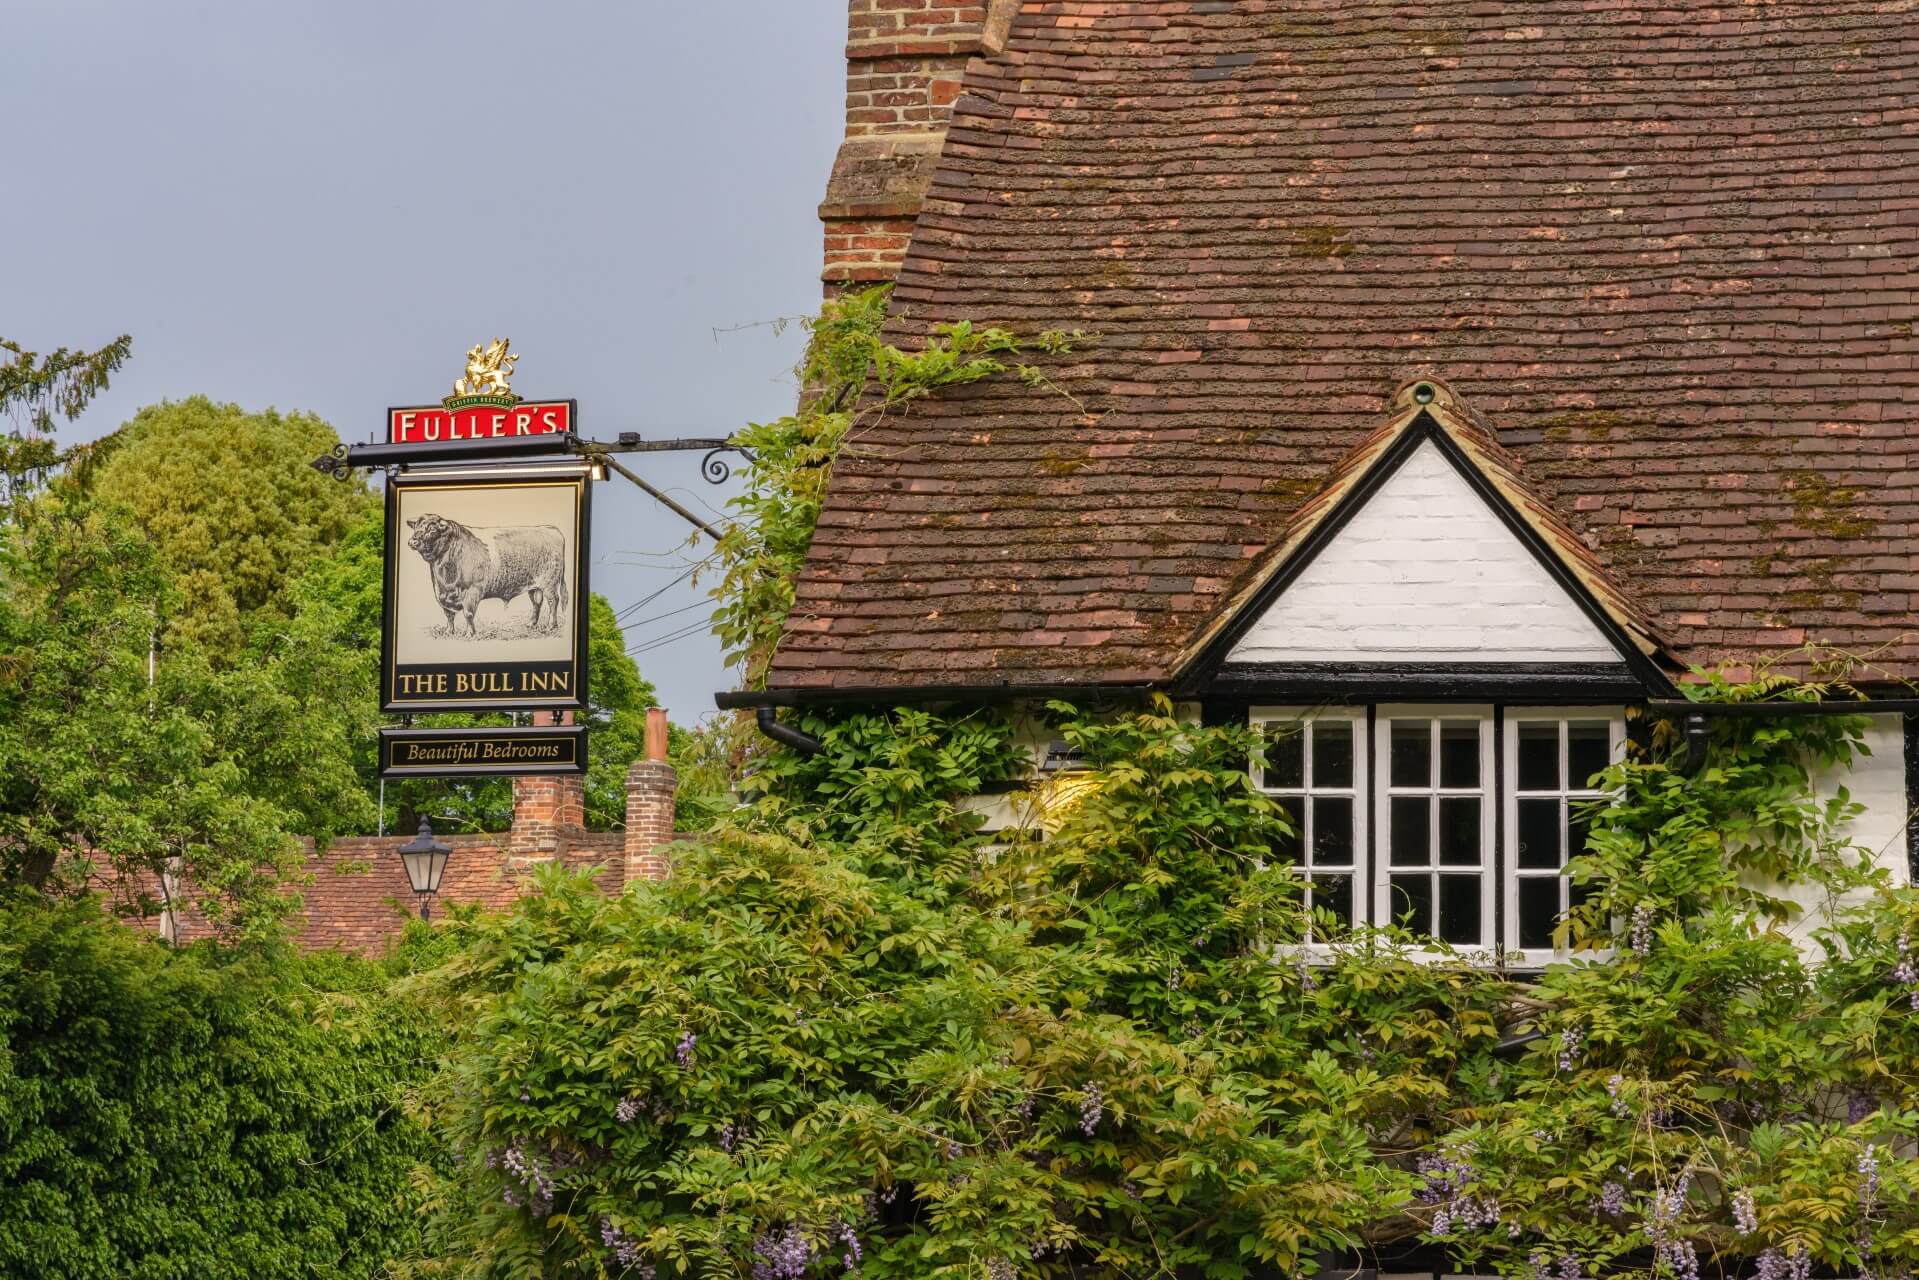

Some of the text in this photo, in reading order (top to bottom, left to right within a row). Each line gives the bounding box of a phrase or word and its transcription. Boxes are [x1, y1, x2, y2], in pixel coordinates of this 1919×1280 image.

[401, 407, 557, 441] FULLER'S
[399, 671, 570, 694] THE BULL INN
[407, 742, 559, 763] Beautiful Bedrooms
